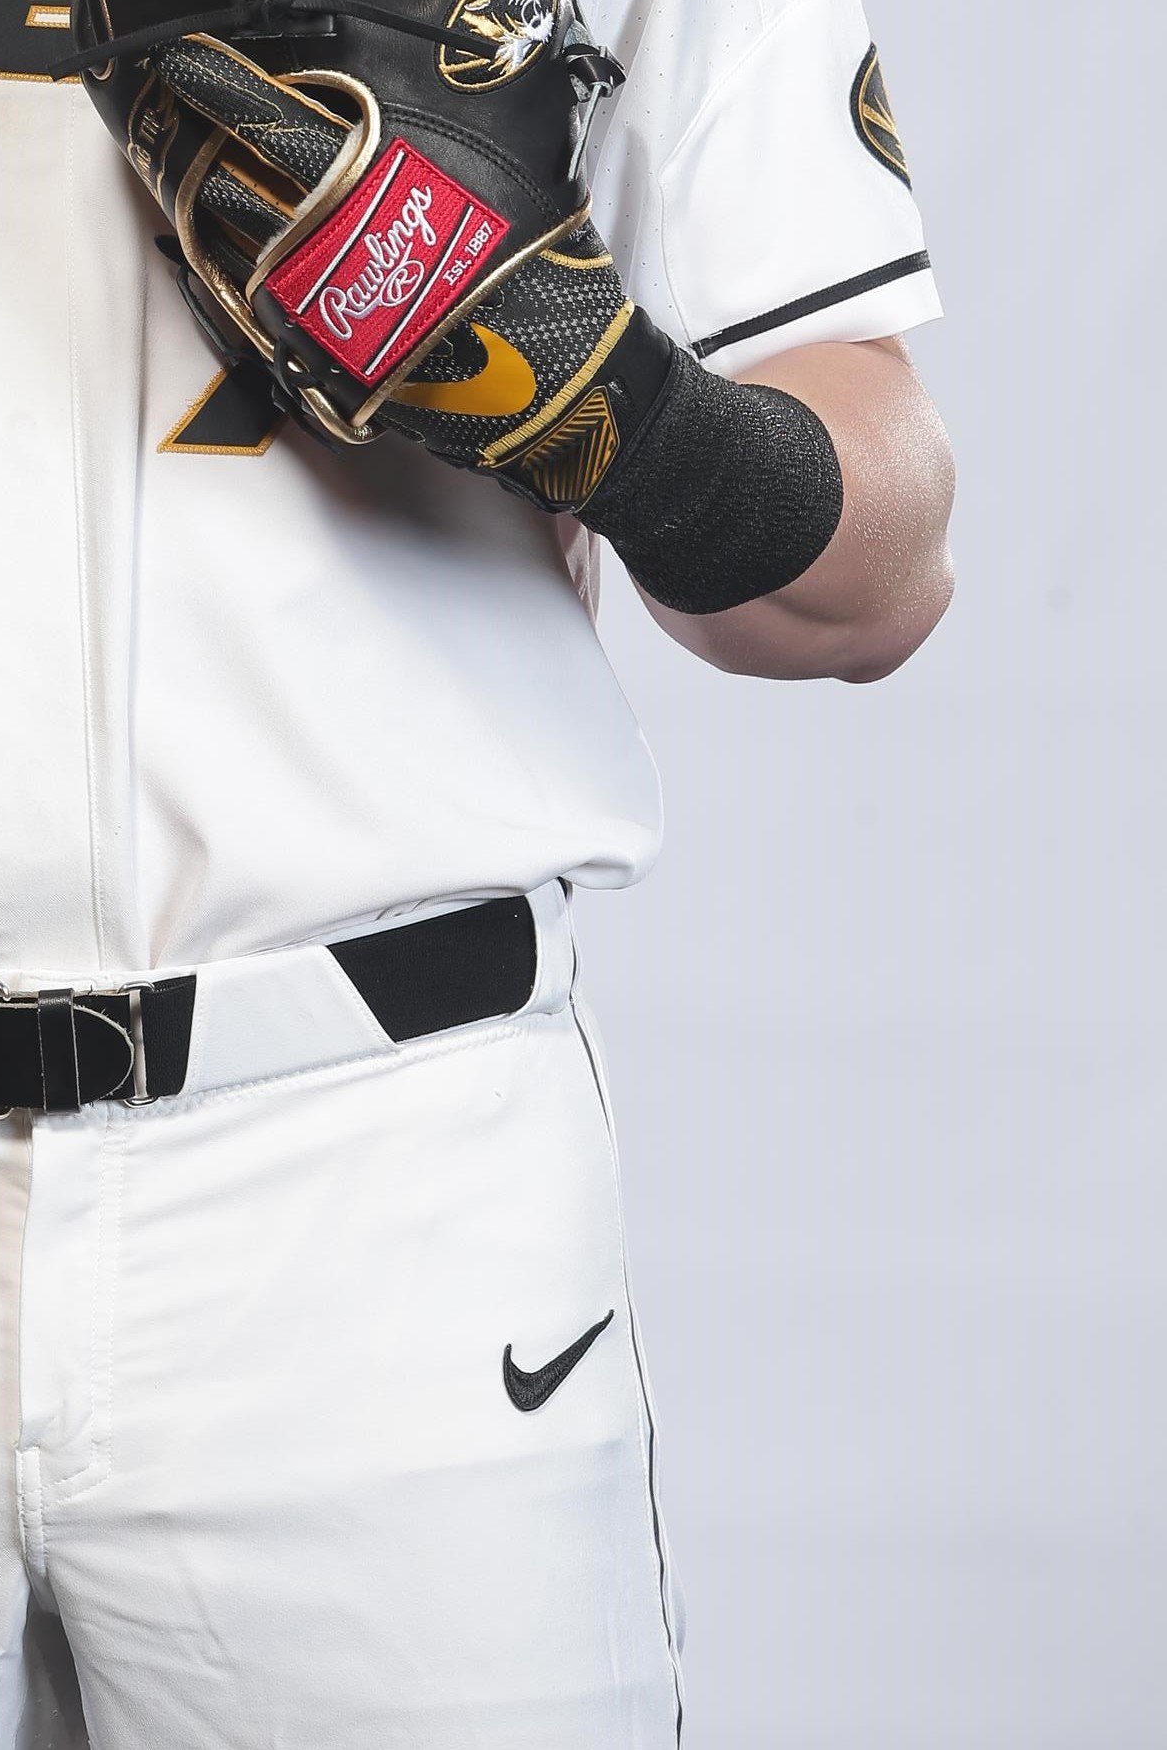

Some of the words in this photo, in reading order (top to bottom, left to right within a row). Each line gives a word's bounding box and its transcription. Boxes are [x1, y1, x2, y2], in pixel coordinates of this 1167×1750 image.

[319, 185, 436, 340] Rawlings
[442, 258, 473, 287] Est.
[463, 220, 494, 260] 1887
